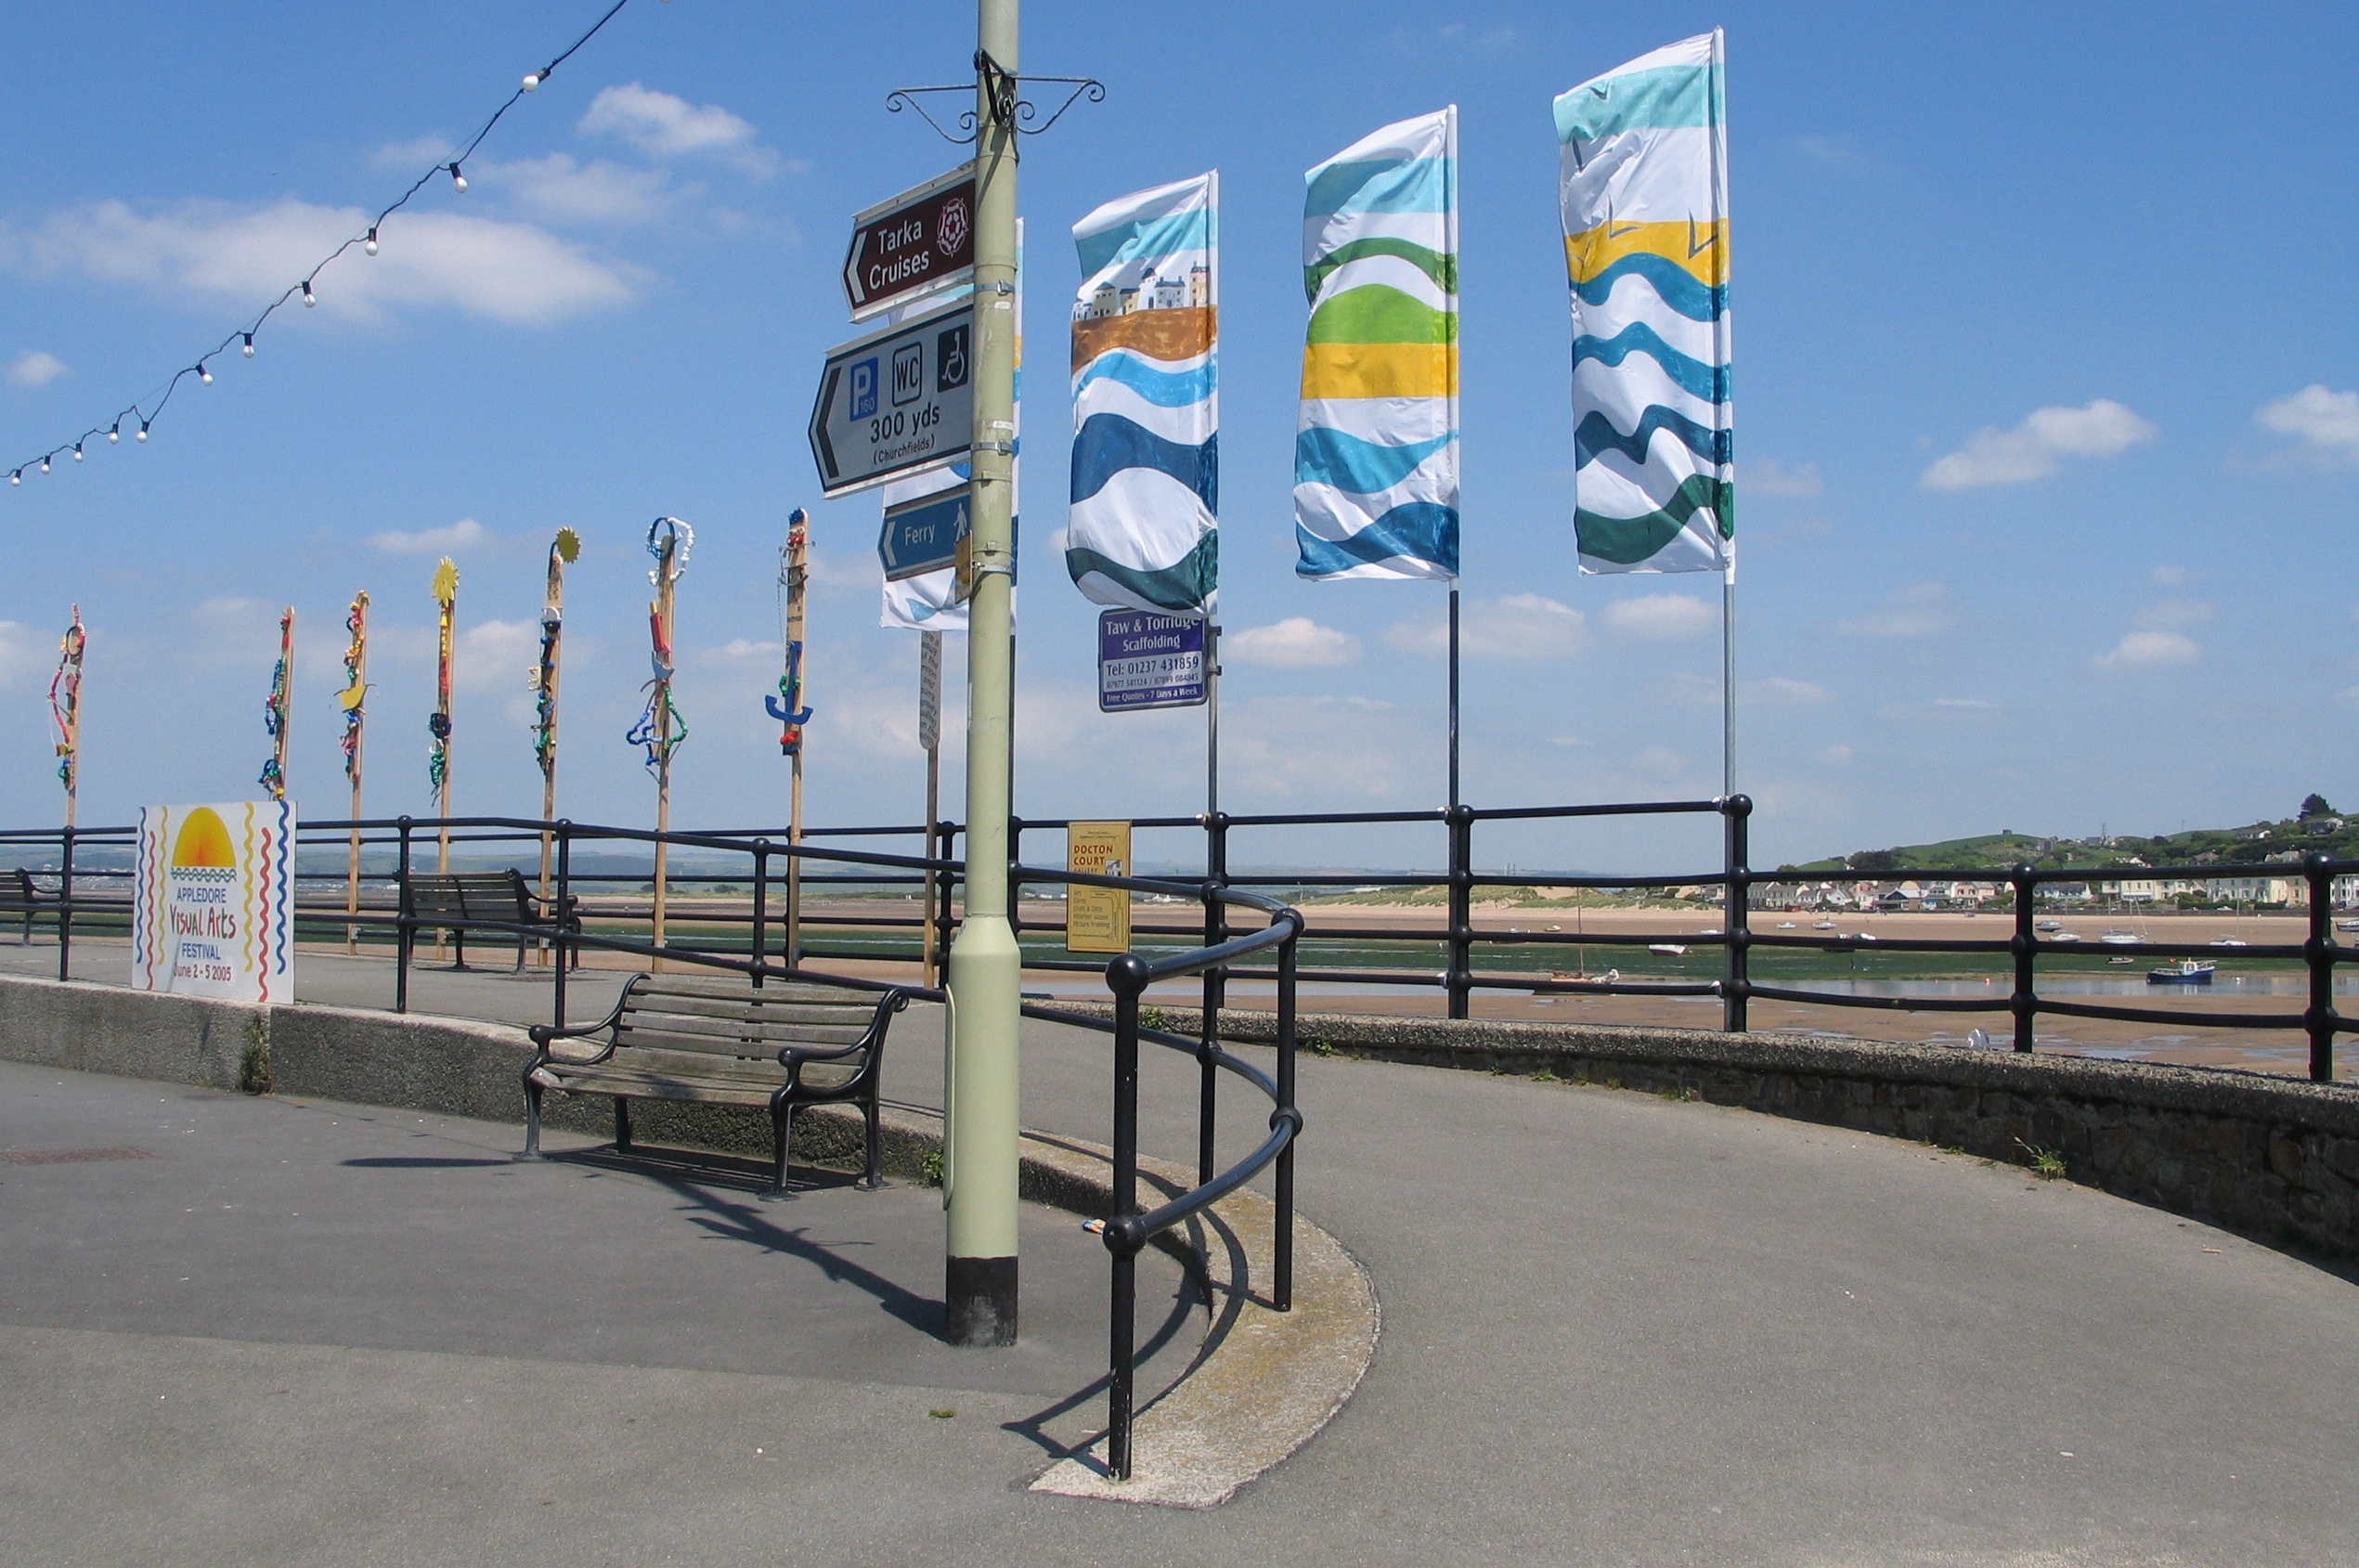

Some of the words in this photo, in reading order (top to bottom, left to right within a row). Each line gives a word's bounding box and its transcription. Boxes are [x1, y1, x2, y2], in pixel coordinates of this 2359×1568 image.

[878, 220, 923, 254] Tarka
[869, 251, 929, 291] Cruises
[896, 356, 919, 392] WC
[871, 410, 904, 444] 300
[912, 402, 940, 436] yds
[874, 433, 935, 465] (Churchfields)
[905, 525, 936, 546] Ferry
[1106, 621, 1130, 636] Taw
[1134, 618, 1142, 632] &
[1122, 634, 1181, 652] Scaffolding
[1107, 663, 1124, 677] Tel:
[1128, 660, 1157, 675] 01237
[1160, 655, 1199, 671] 431859
[1150, 691, 1155, 699] 7
[1156, 689, 1173, 700] Days
[1173, 689, 1178, 697] a
[1179, 685, 1199, 696] Week
[1074, 845, 1113, 854] DOCTON
[1073, 856, 1105, 865] COURT
[176, 887, 227, 903] APPLEDORE
[207, 906, 237, 940] Arts
[182, 942, 221, 960] FESTIVAL
[174, 965, 191, 978] June
[193, 964, 198, 978] 2
[205, 965, 211, 979] 5
[212, 965, 232, 981] 2005
